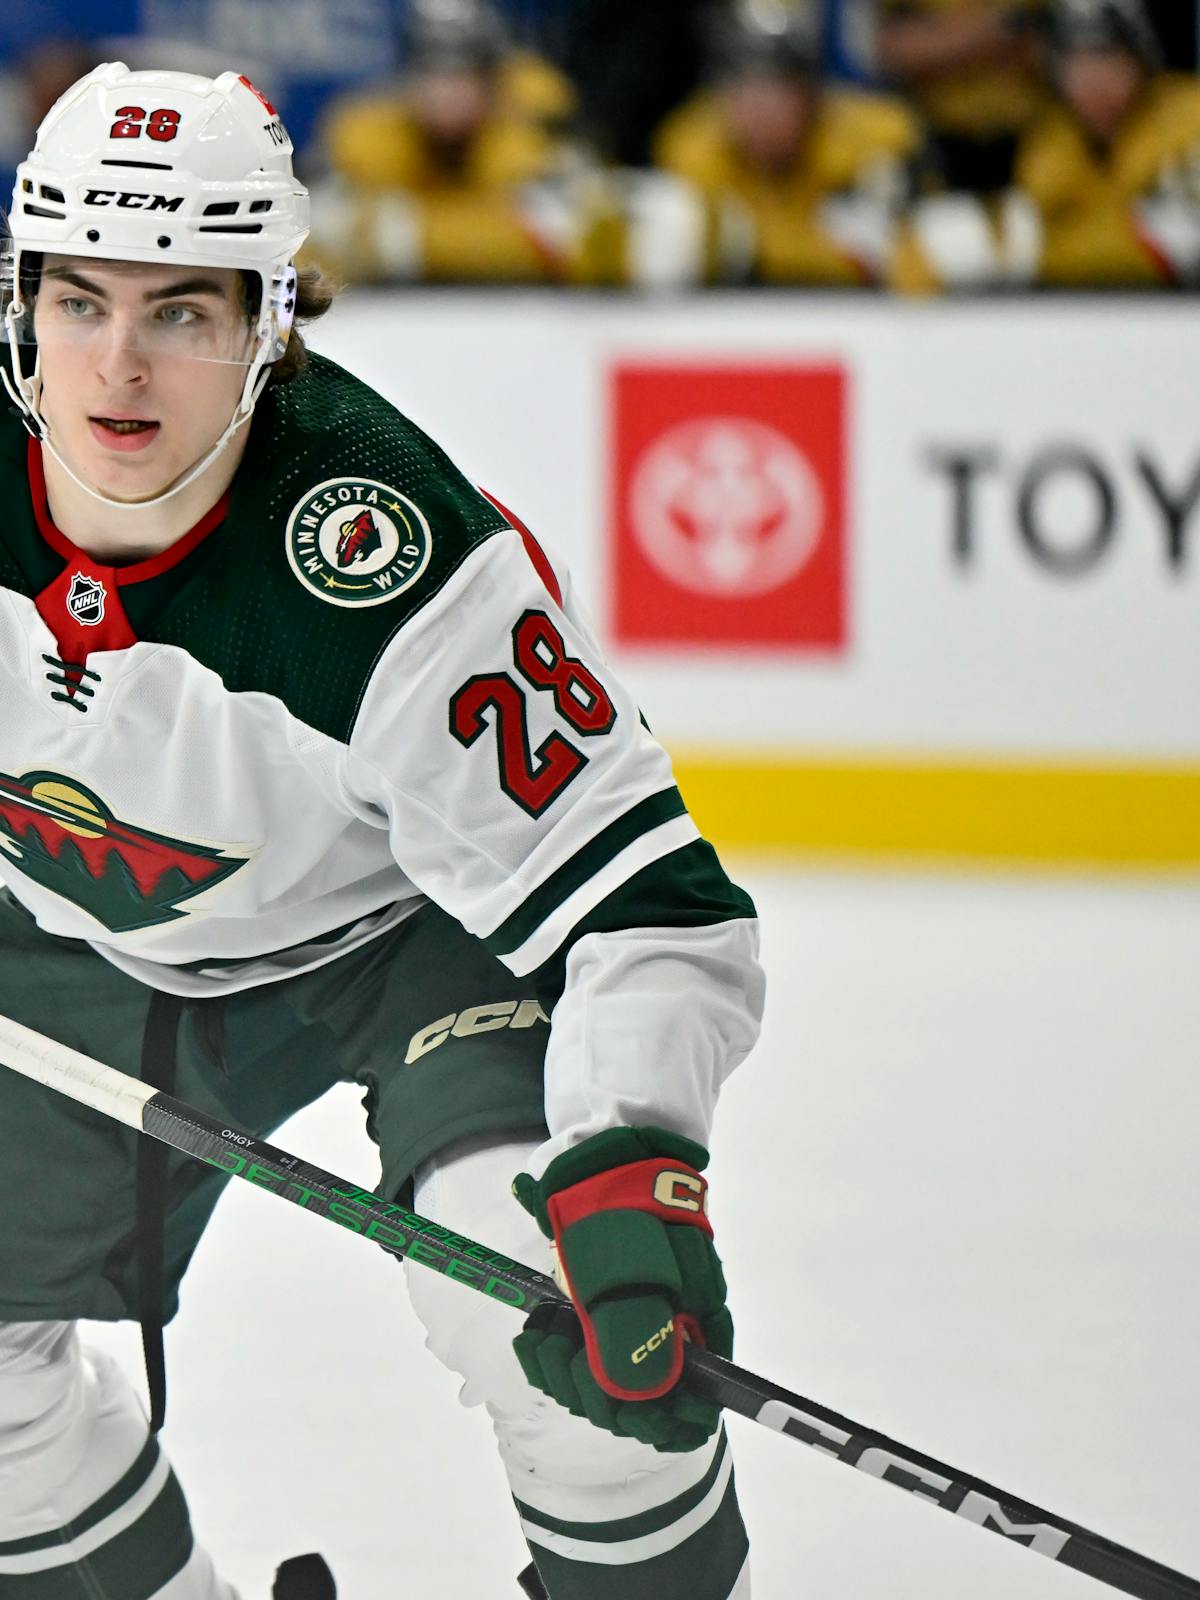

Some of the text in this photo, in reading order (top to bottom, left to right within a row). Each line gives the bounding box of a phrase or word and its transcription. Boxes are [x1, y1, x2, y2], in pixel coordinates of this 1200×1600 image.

[109, 105, 182, 142] 28
[83, 188, 185, 213] CCM
[296, 486, 421, 590] MINNESOTA WILD
[73, 592, 98, 611] NHL
[448, 608, 618, 821] 28
[221, 1129, 255, 1148] OHGY
[204, 1150, 527, 1308] JETSPEED
[331, 1187, 516, 1272] JETSPEED
[631, 1319, 674, 1365] CCM
[755, 1399, 1071, 1560] CCM
